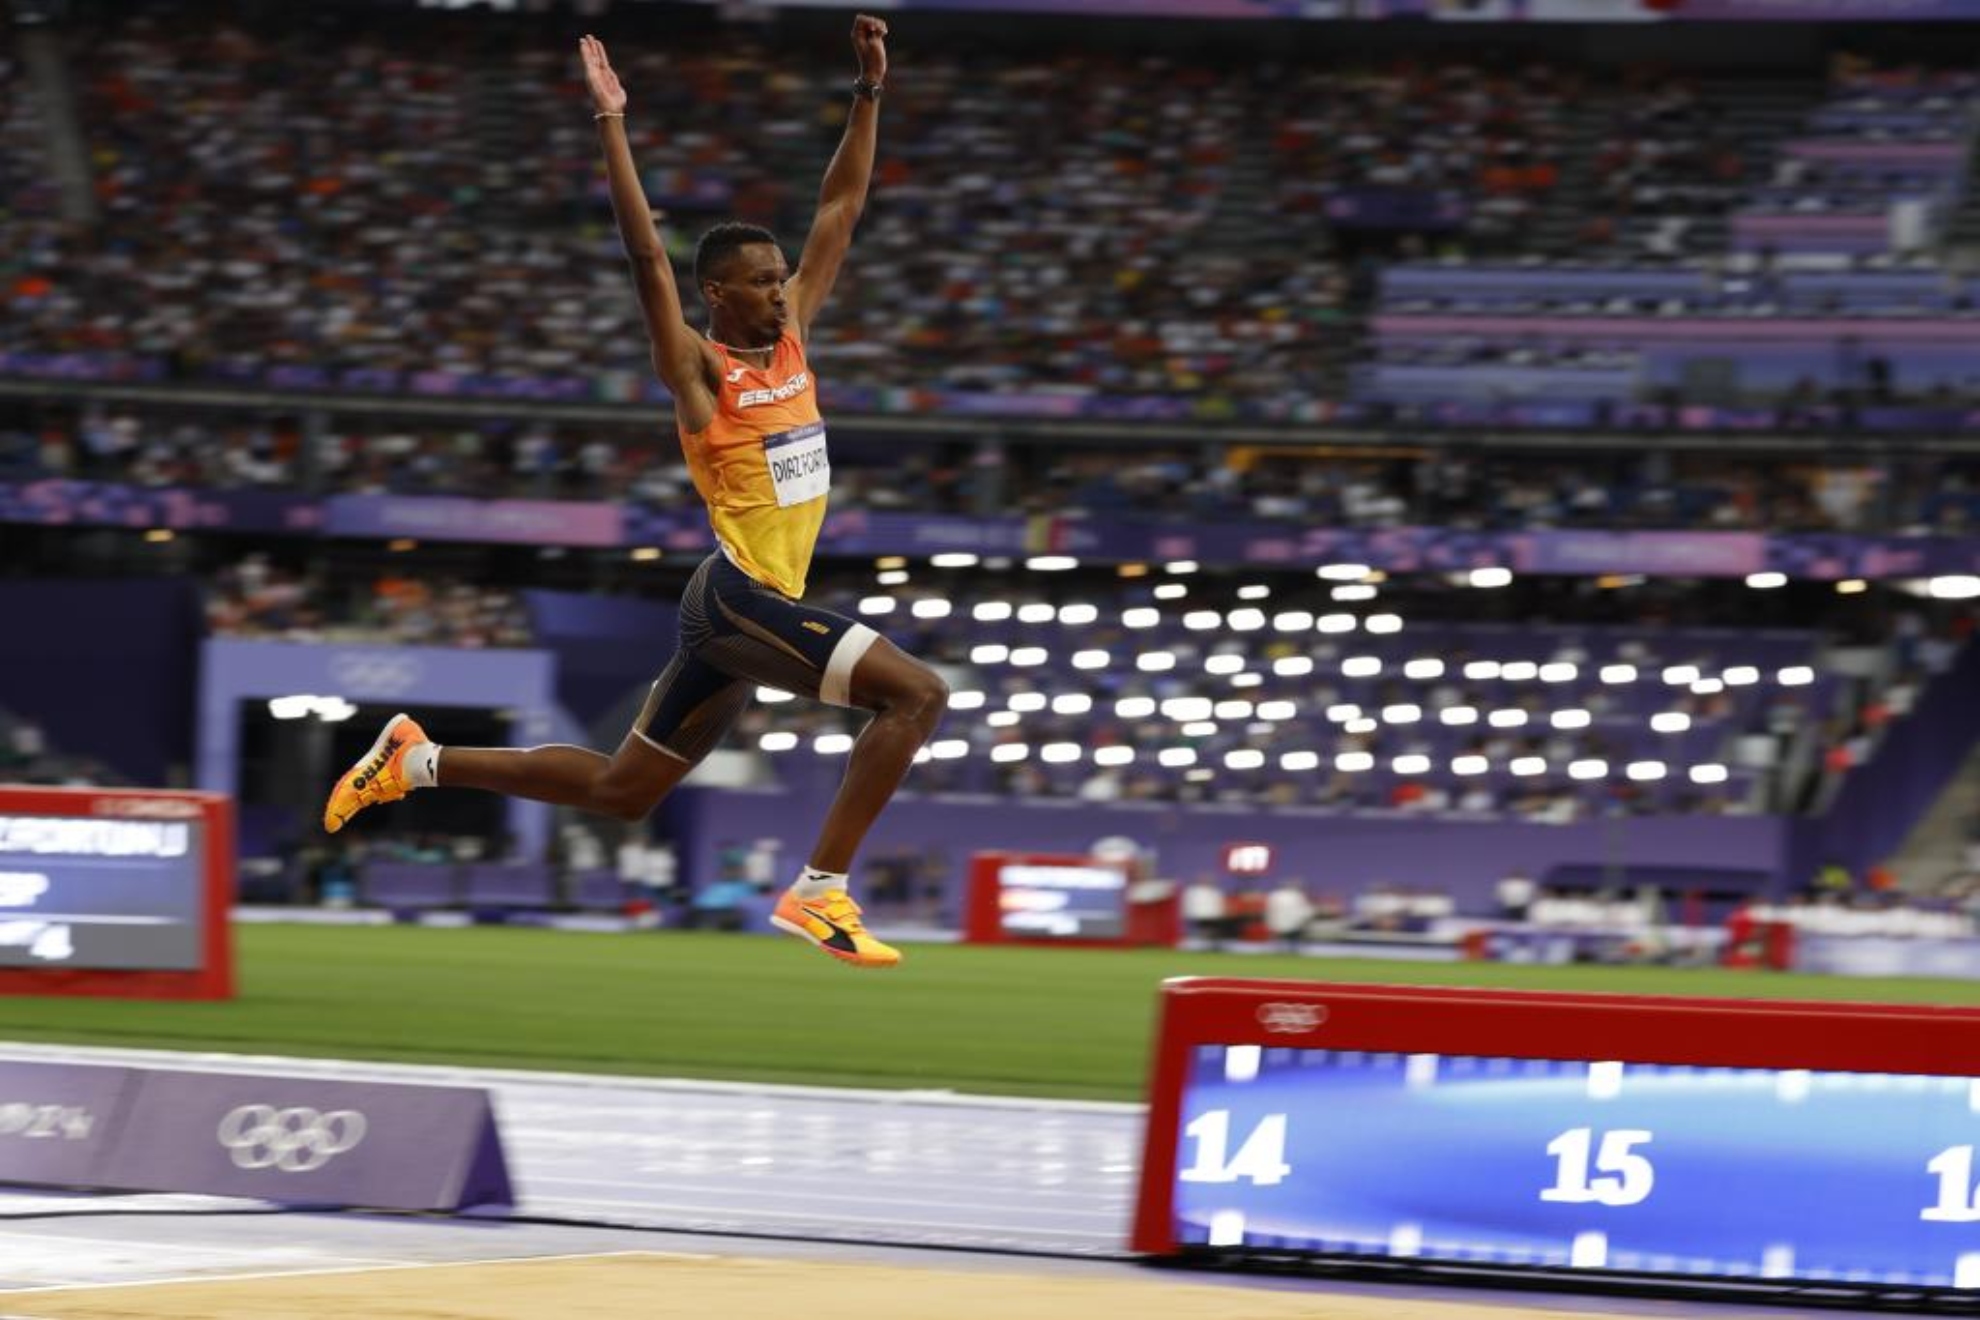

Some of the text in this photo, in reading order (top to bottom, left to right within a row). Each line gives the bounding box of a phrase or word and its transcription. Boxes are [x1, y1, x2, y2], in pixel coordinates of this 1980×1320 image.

[772, 456, 802, 484] DIAZ
[352, 736, 404, 791] NITRO
[1178, 1110, 1980, 1222] 14 15 1
